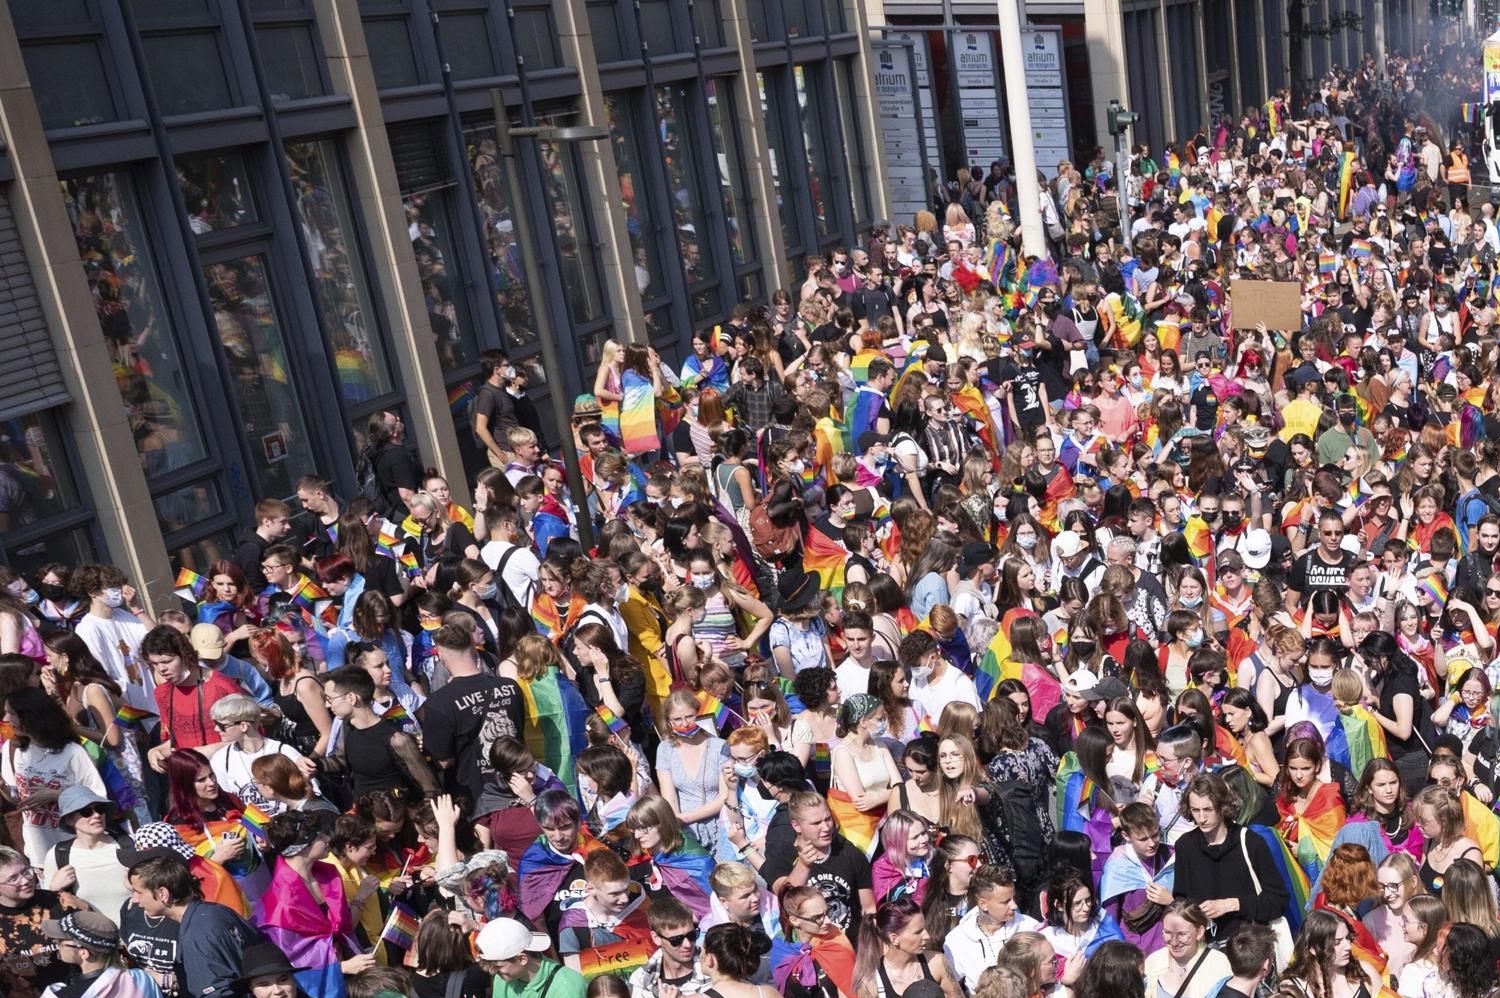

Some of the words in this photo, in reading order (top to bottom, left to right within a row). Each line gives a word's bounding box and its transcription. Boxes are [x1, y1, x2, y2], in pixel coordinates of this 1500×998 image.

[960, 52, 987, 64] atrium
[1027, 52, 1055, 63] atrium
[455, 691, 484, 711] LIVE
[491, 684, 517, 700] AST
[596, 950, 630, 967] Free
